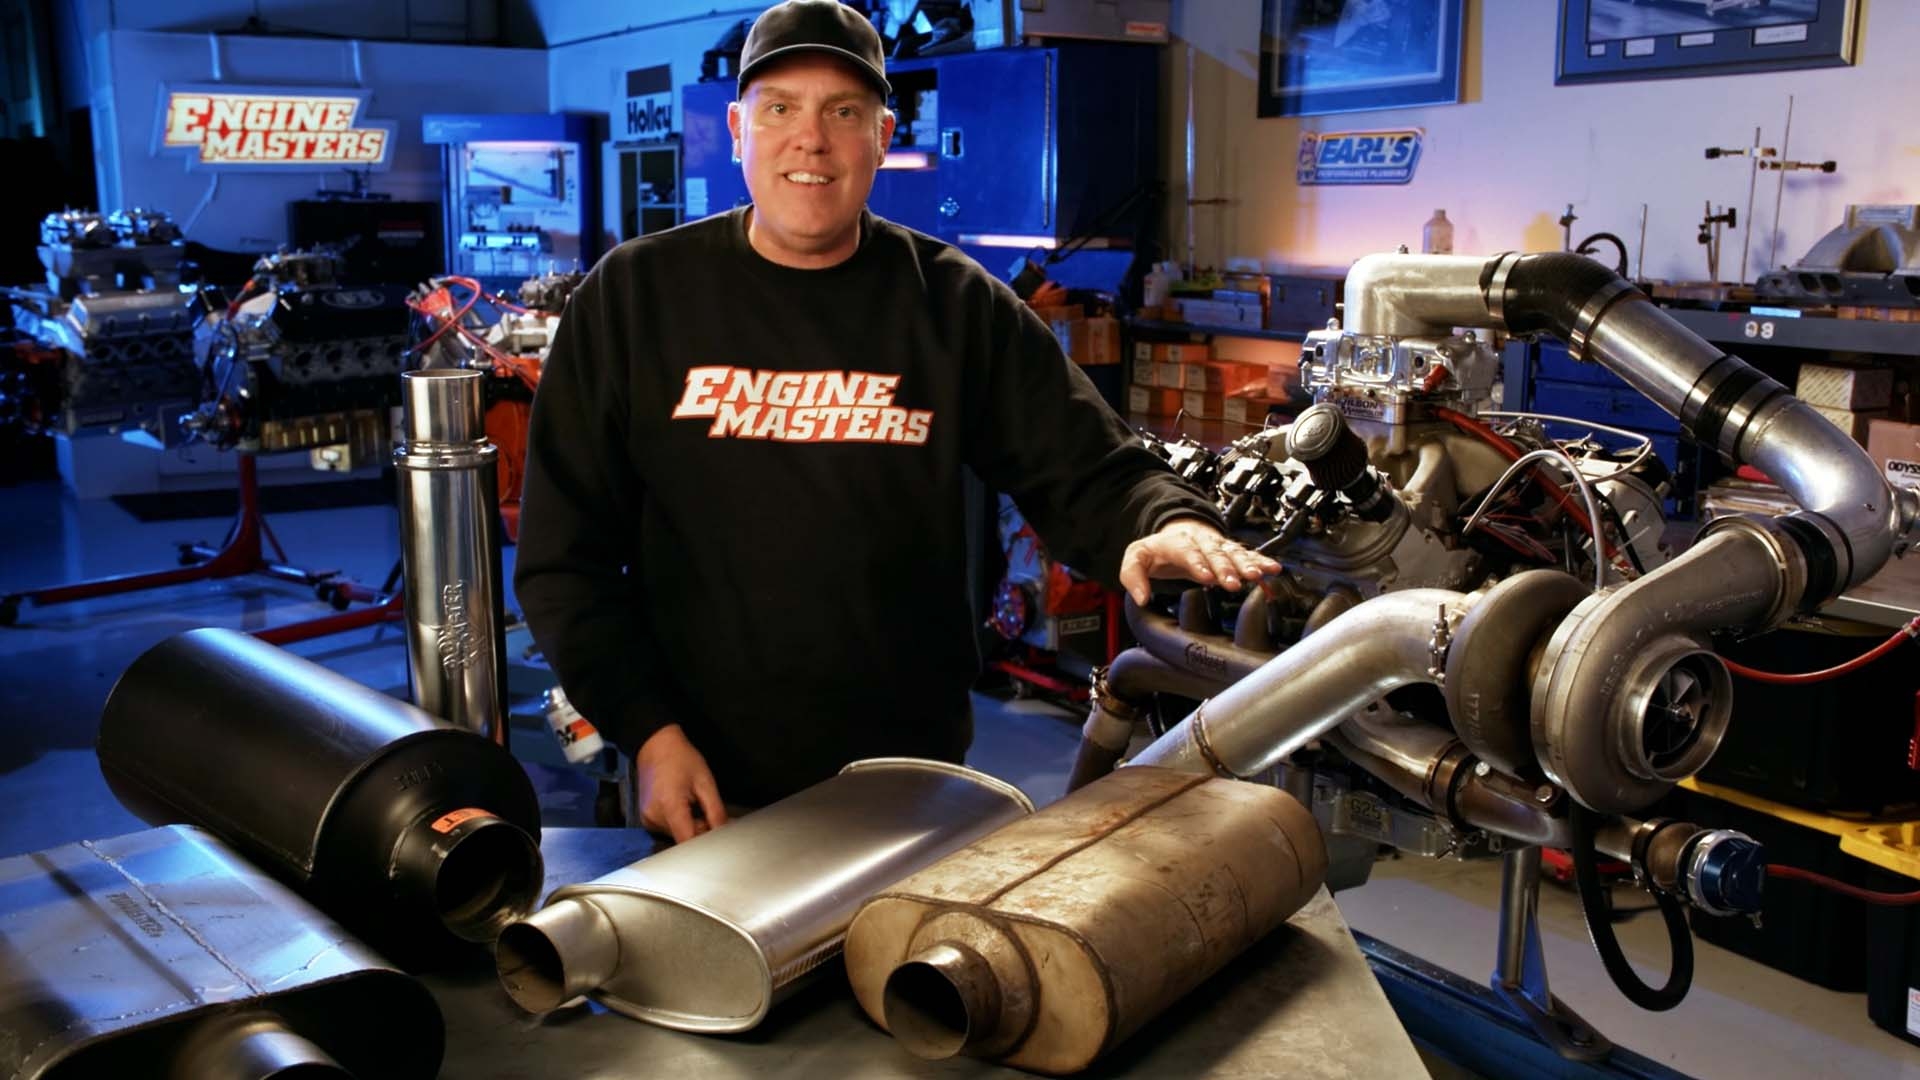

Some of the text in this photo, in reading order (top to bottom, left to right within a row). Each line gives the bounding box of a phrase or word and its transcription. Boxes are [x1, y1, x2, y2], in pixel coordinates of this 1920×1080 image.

[165, 94, 355, 144] ENGINE
[626, 98, 672, 135] Holley
[201, 130, 385, 160] MASTERS
[1319, 136, 1413, 163] EARL'S
[672, 366, 900, 419] ENGINE
[708, 402, 934, 444] MASTERS
